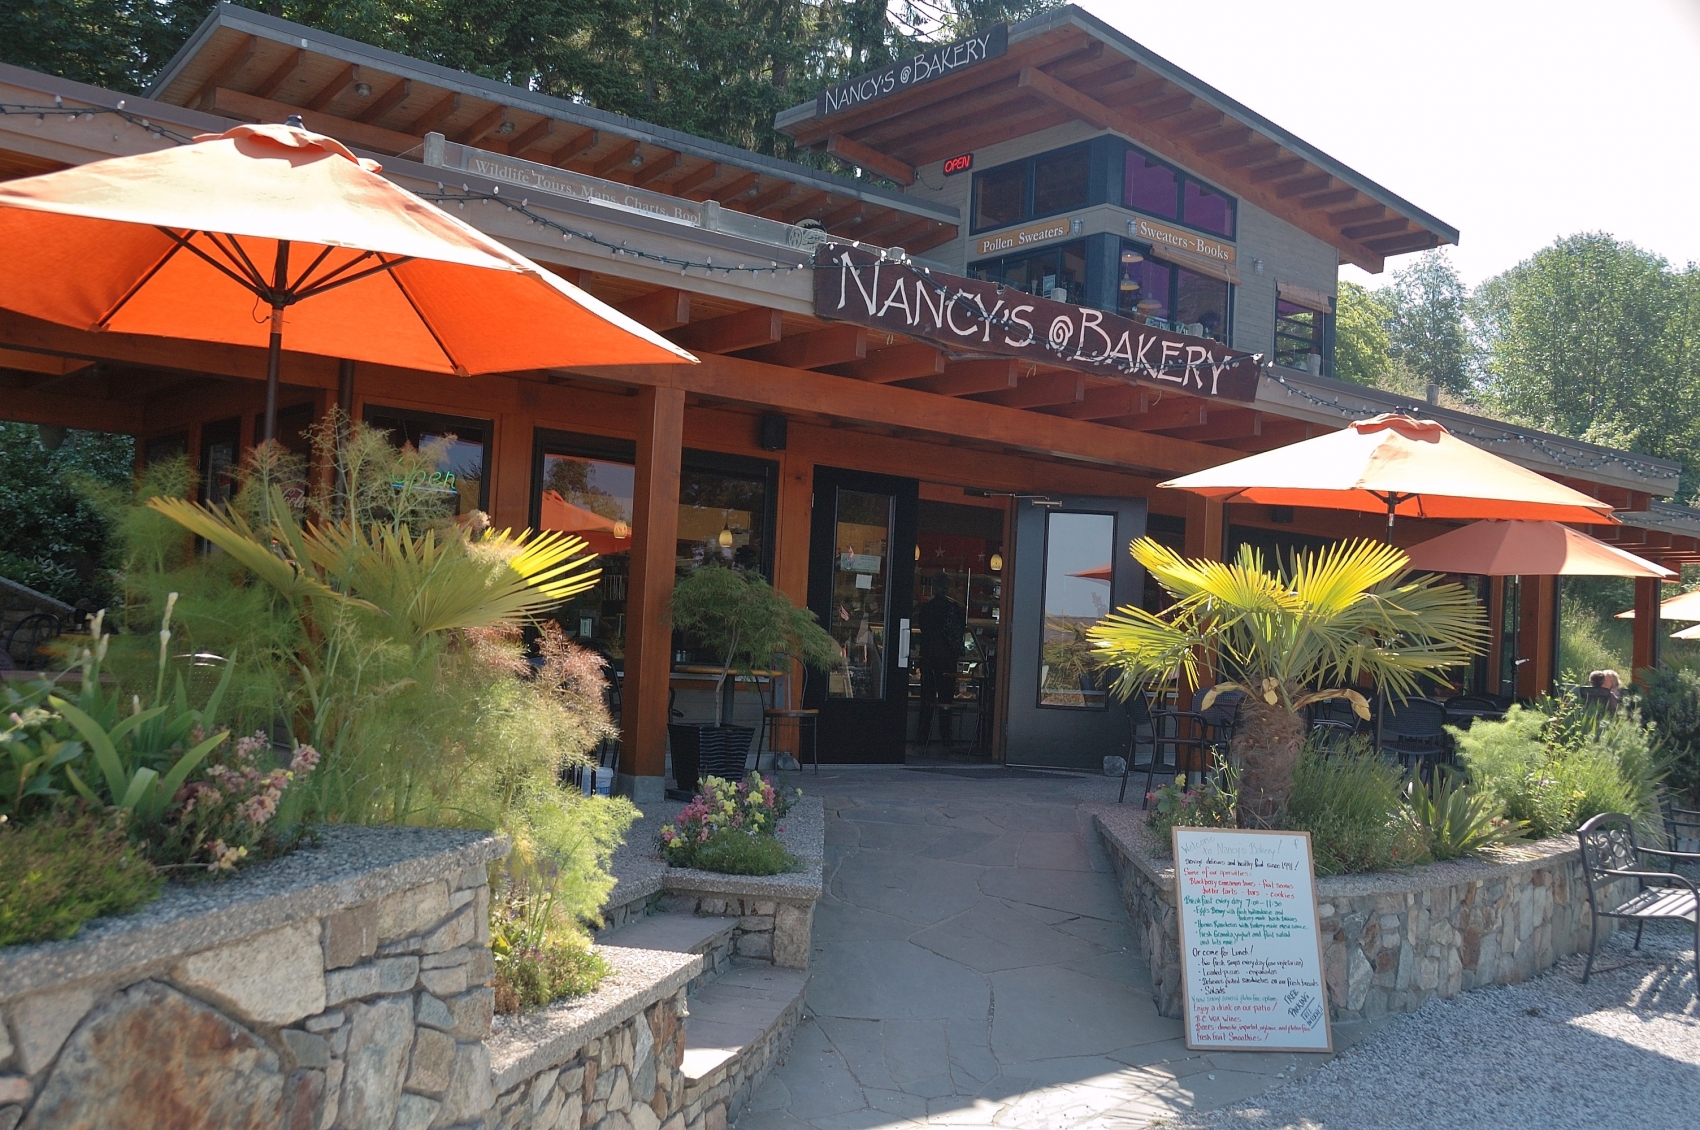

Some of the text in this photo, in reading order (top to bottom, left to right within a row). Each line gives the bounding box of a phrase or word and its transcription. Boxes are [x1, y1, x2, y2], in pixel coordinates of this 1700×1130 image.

[912, 33, 990, 83] BAKERY
[944, 154, 971, 173] OPEN
[475, 159, 530, 183] Wildlife
[534, 172, 576, 196] Tours,
[983, 226, 1064, 253] Pollen Sweaters
[837, 251, 1232, 395] NANCY'S BAKERY
[1181, 836, 1215, 854] Welcome
[1202, 847, 1212, 856] to
[1192, 946, 1201, 957] Or
[1283, 988, 1300, 1005] FREE
[1287, 991, 1310, 1018] PARKING
[1193, 1002, 1210, 1015] Enjoy
